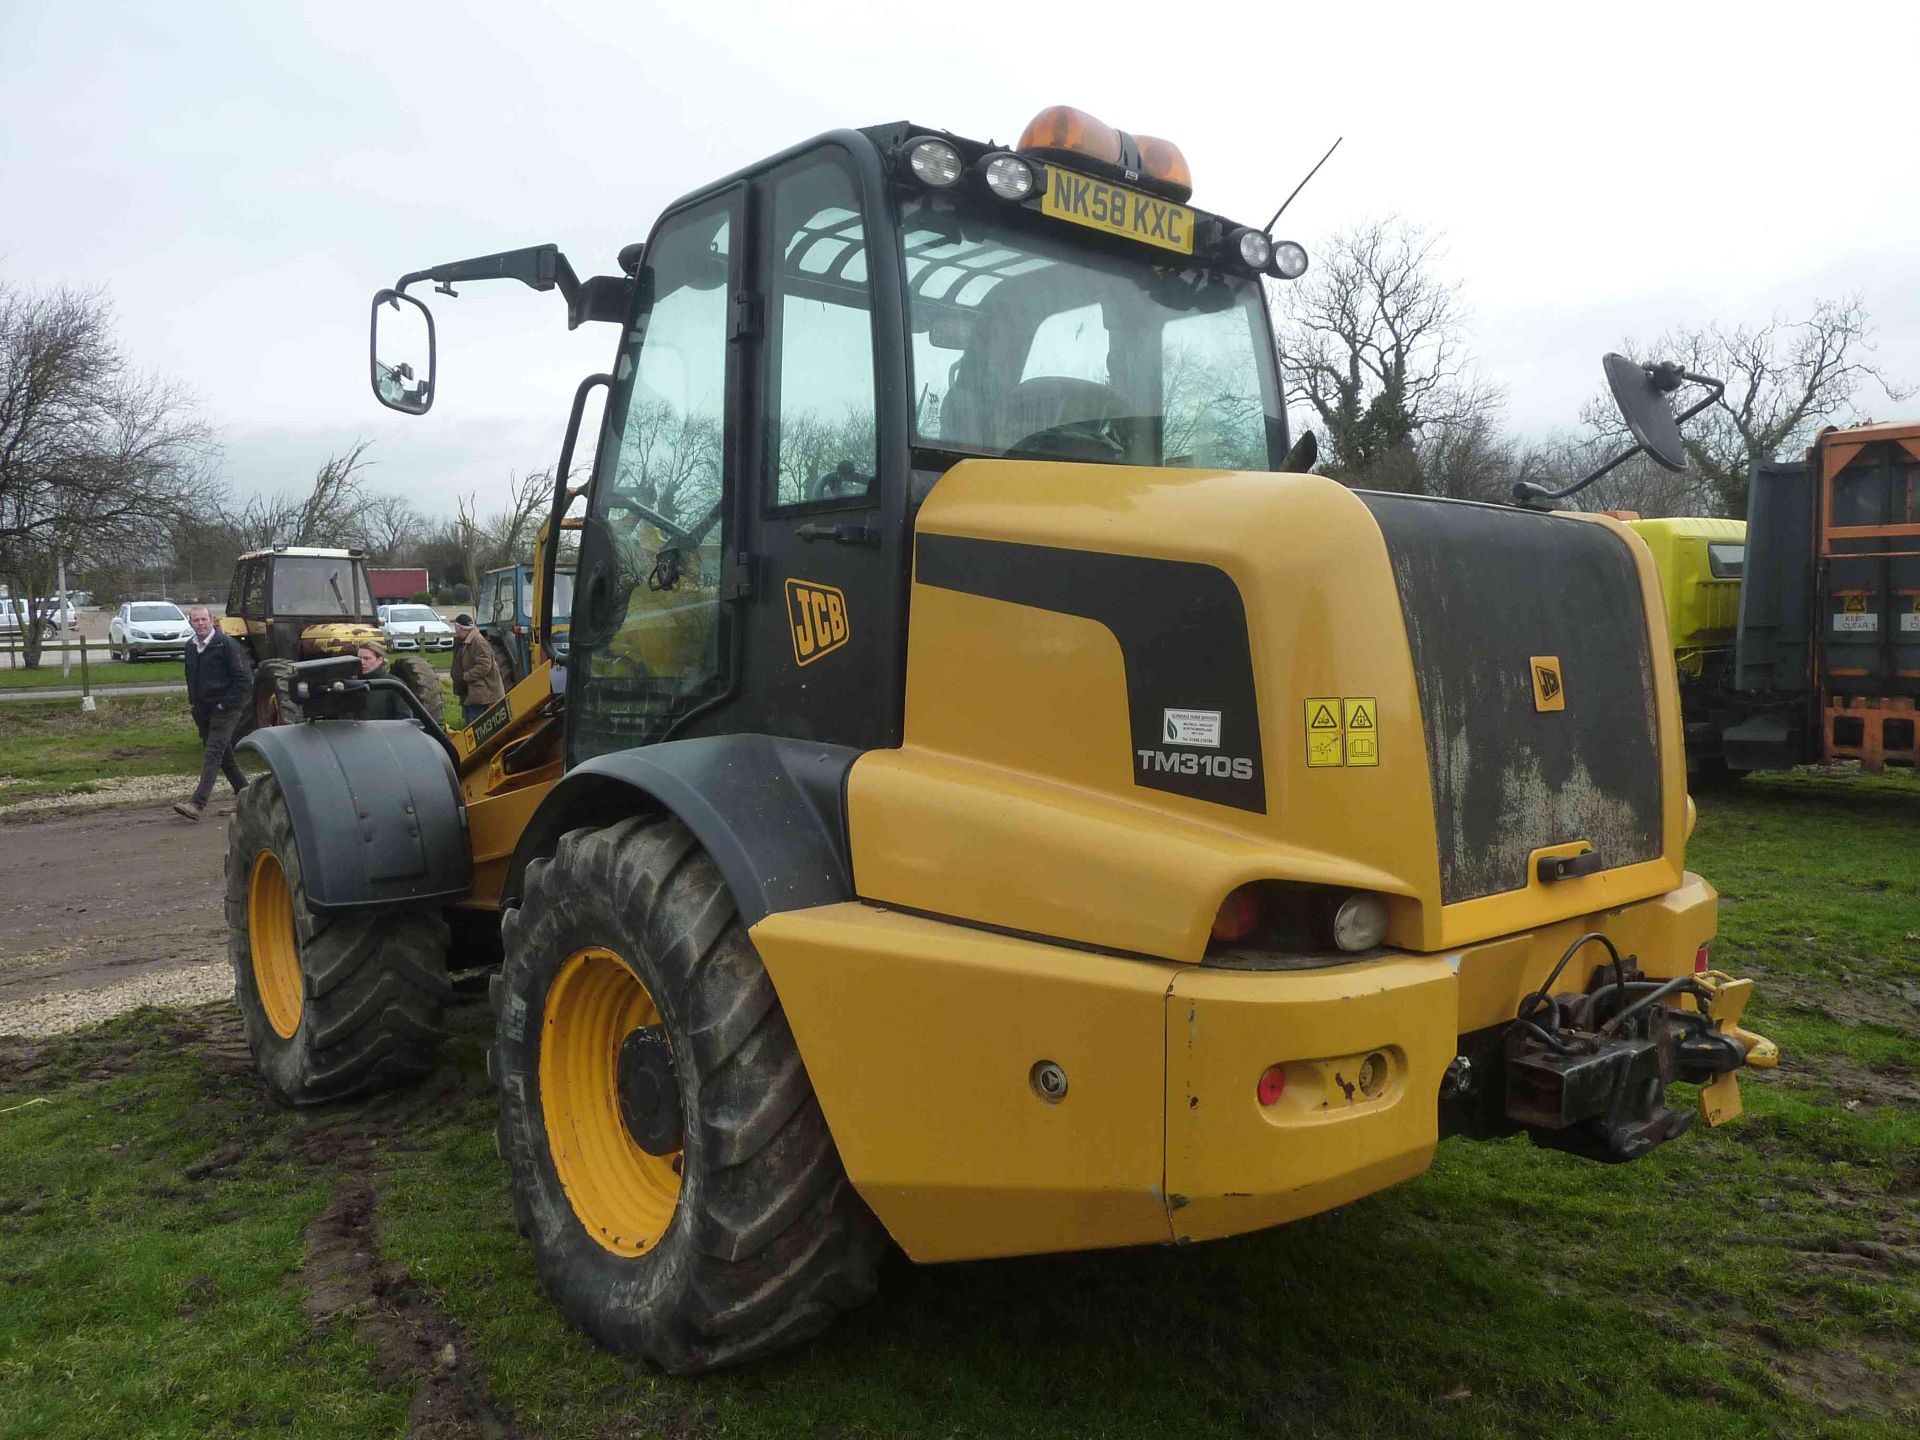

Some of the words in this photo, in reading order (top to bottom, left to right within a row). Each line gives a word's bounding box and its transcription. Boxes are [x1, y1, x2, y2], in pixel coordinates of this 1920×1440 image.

[1054, 172, 1126, 227] NK58
[1133, 194, 1183, 244] KXC
[796, 587, 845, 656] JCB
[474, 707, 507, 740] TM310S
[1137, 749, 1253, 780] TM310S
